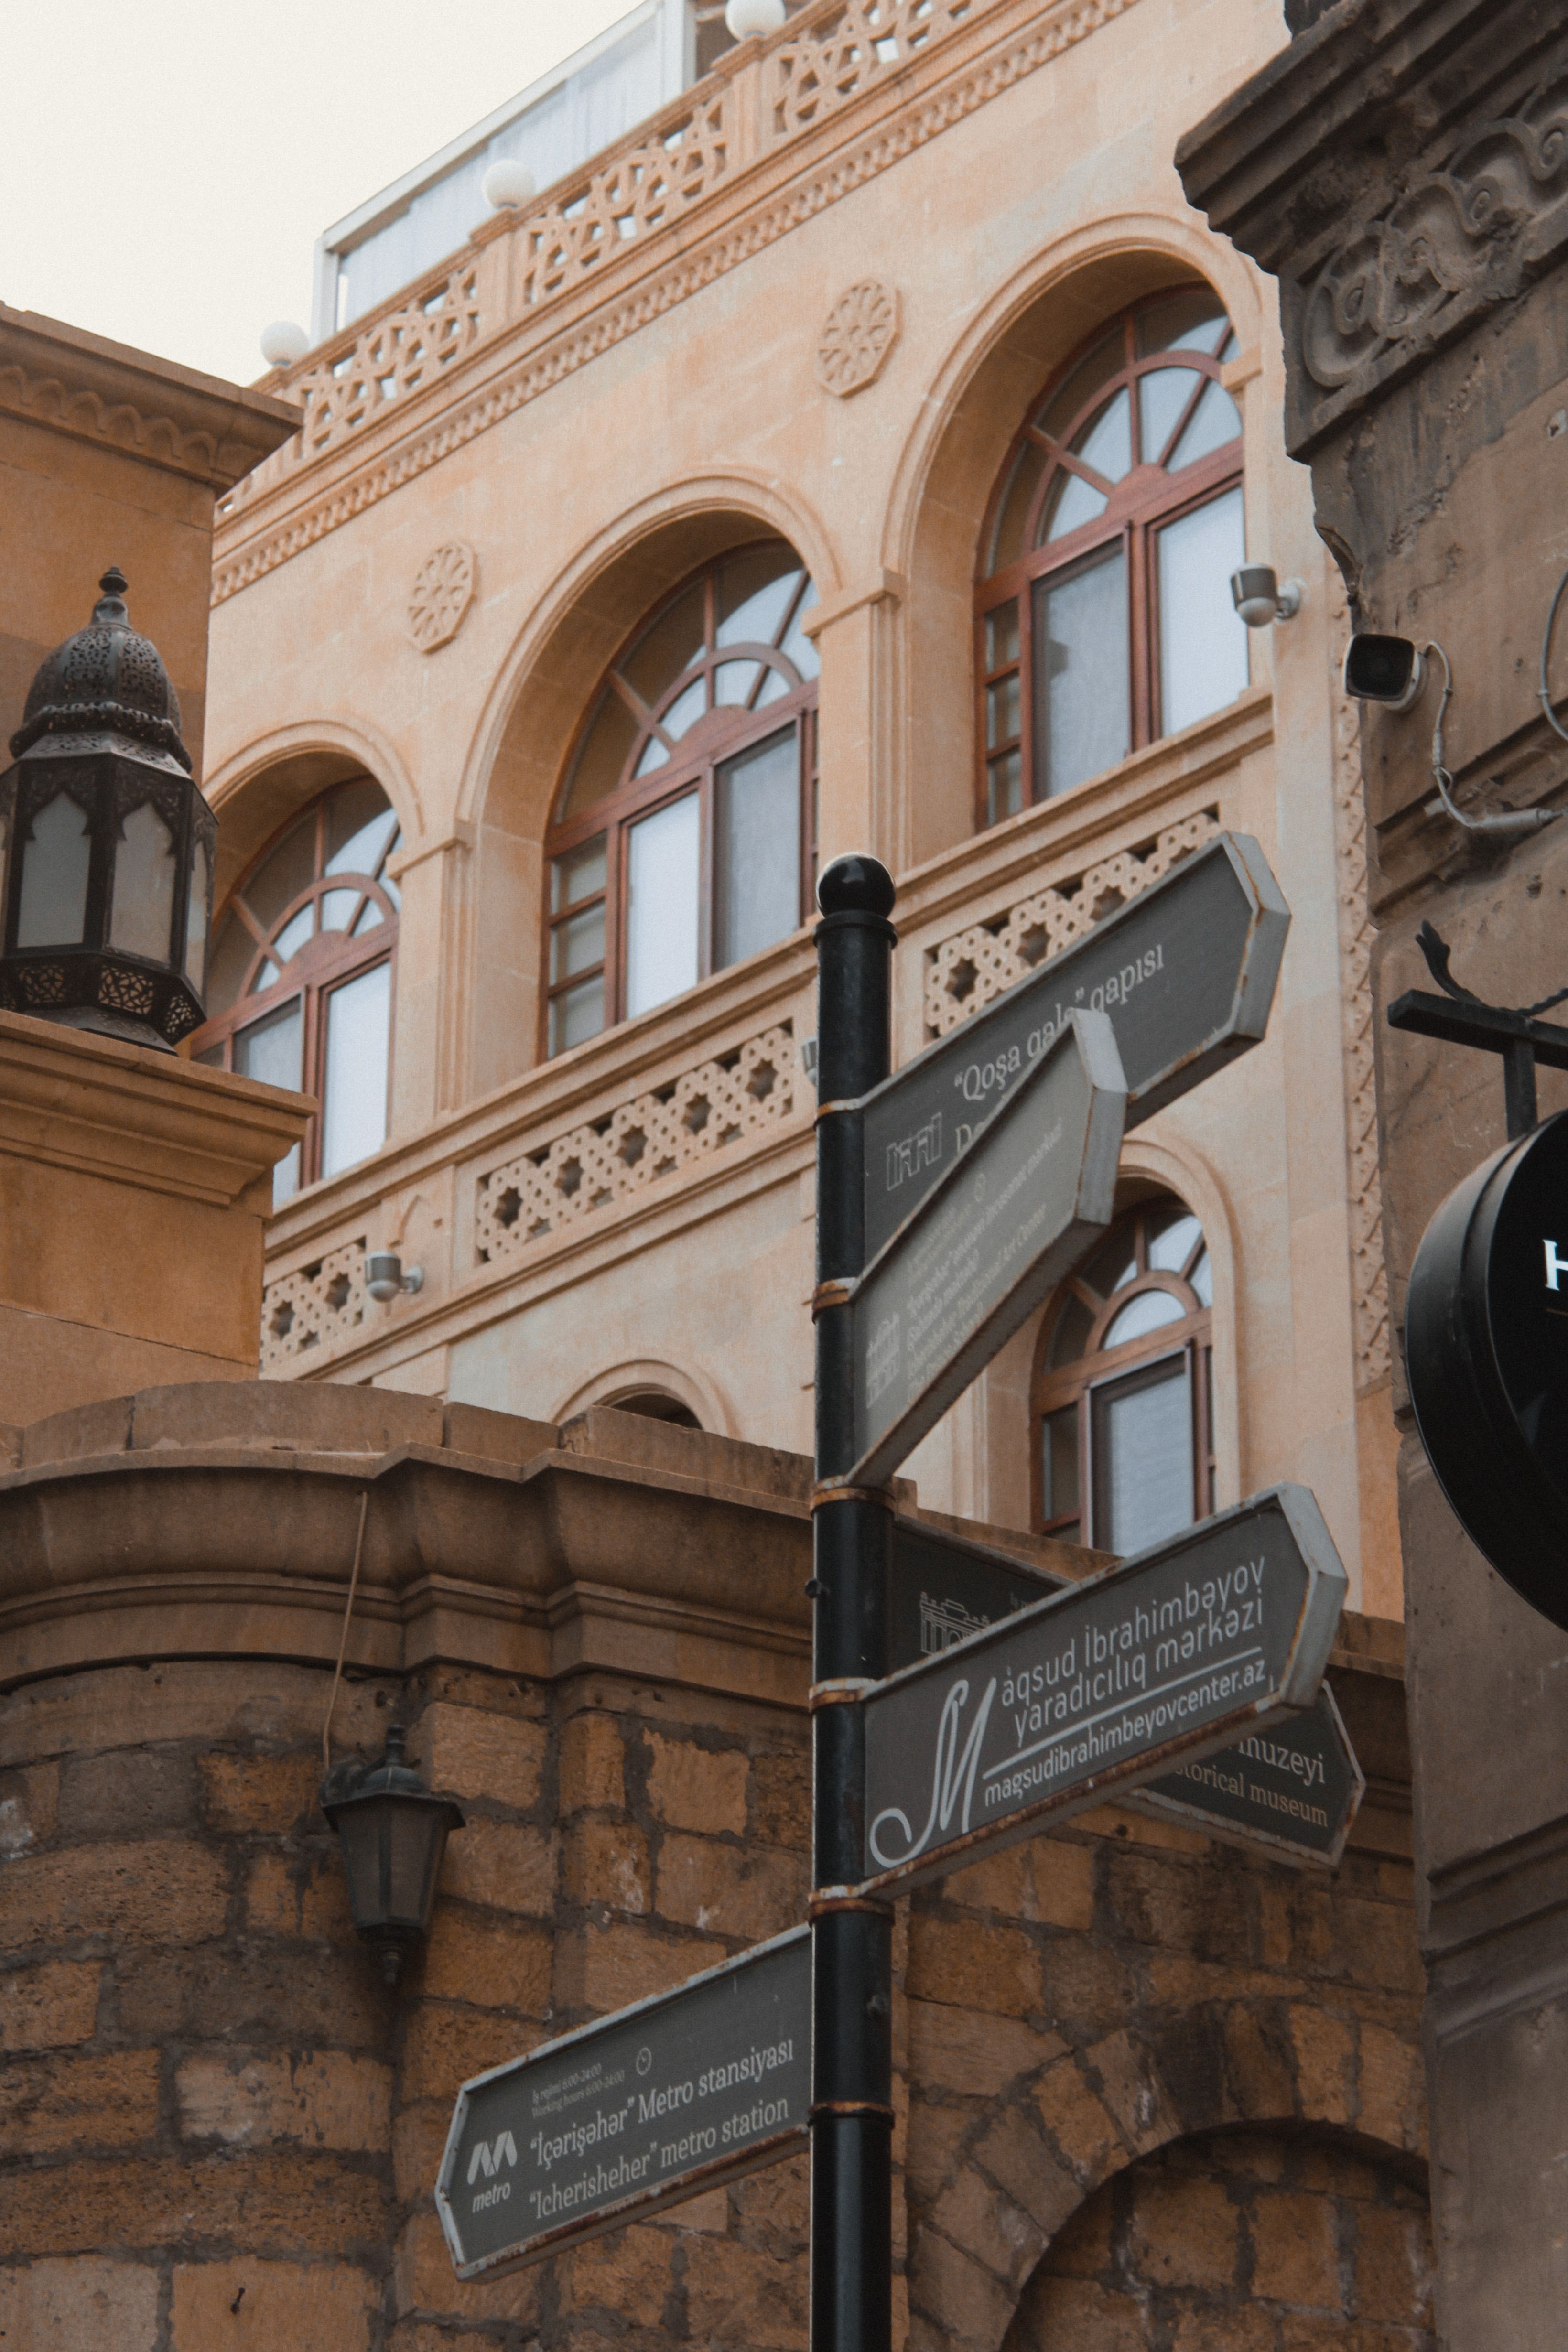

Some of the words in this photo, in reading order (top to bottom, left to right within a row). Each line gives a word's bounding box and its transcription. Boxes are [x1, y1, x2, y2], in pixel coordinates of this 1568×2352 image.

[1091, 944, 1165, 1014] qapısı
[1014, 1651, 1146, 1748] yaradıcılıq
[1156, 1586, 1263, 1672] mərkəzi
[1249, 1783, 1329, 1829] museum
[638, 2081, 693, 2125] Metro
[698, 2039, 794, 2099] stansiyası
[660, 2125, 717, 2168] metro
[721, 2097, 790, 2144] station
[471, 2182, 511, 2214] metro
